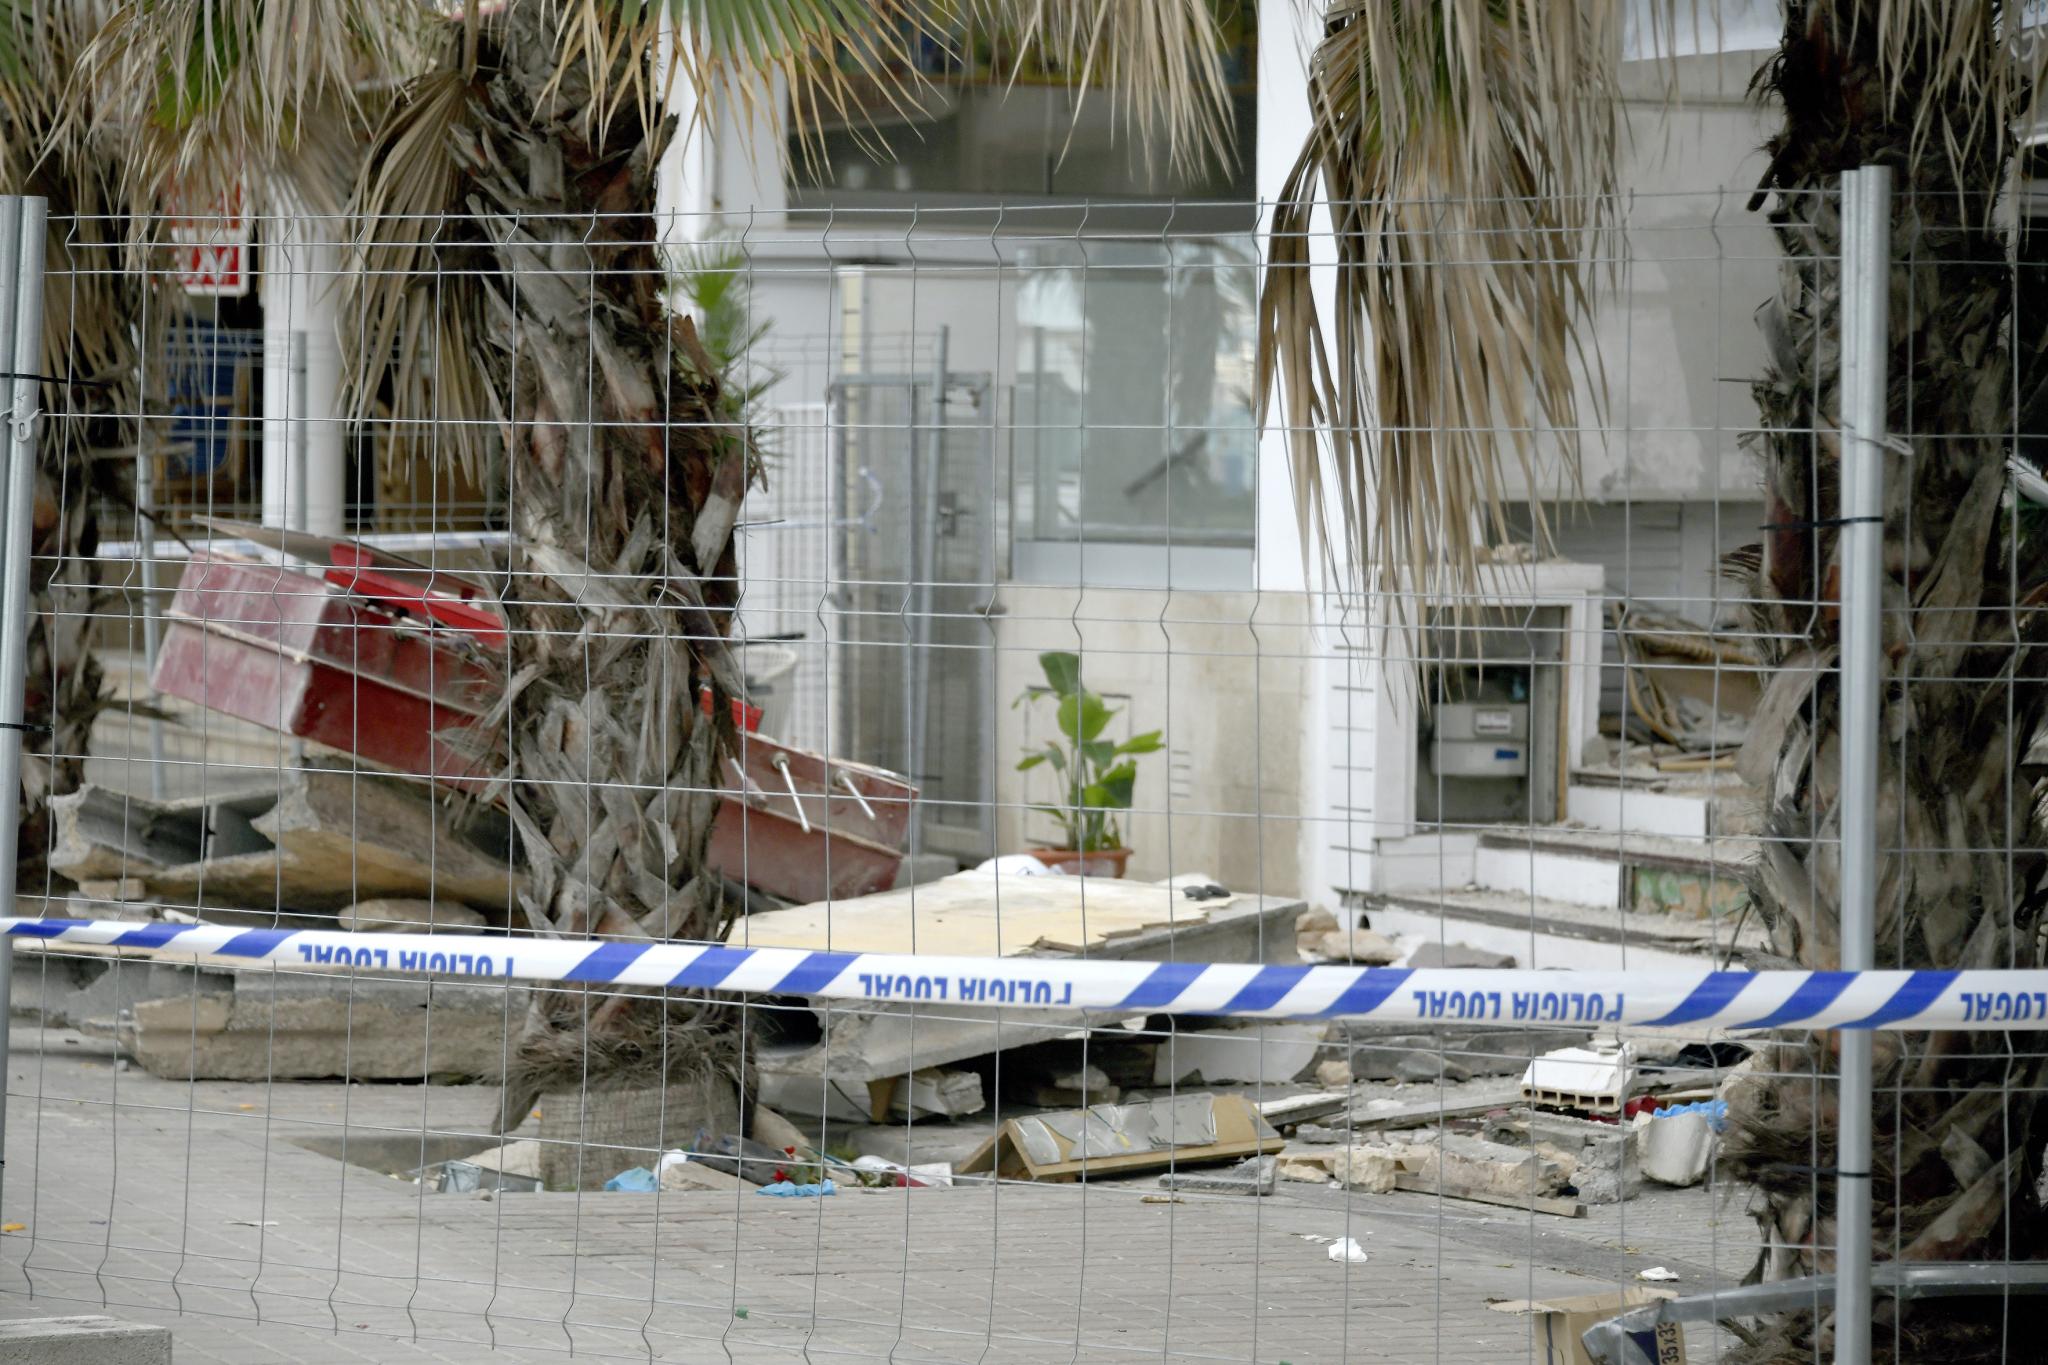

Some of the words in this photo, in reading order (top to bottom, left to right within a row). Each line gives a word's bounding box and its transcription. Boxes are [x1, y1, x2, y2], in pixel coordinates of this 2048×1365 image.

[1412, 990, 1503, 1017] LOCAL
[1513, 991, 1625, 1020] POLICIA
[1959, 991, 2048, 1020] LOCAL
